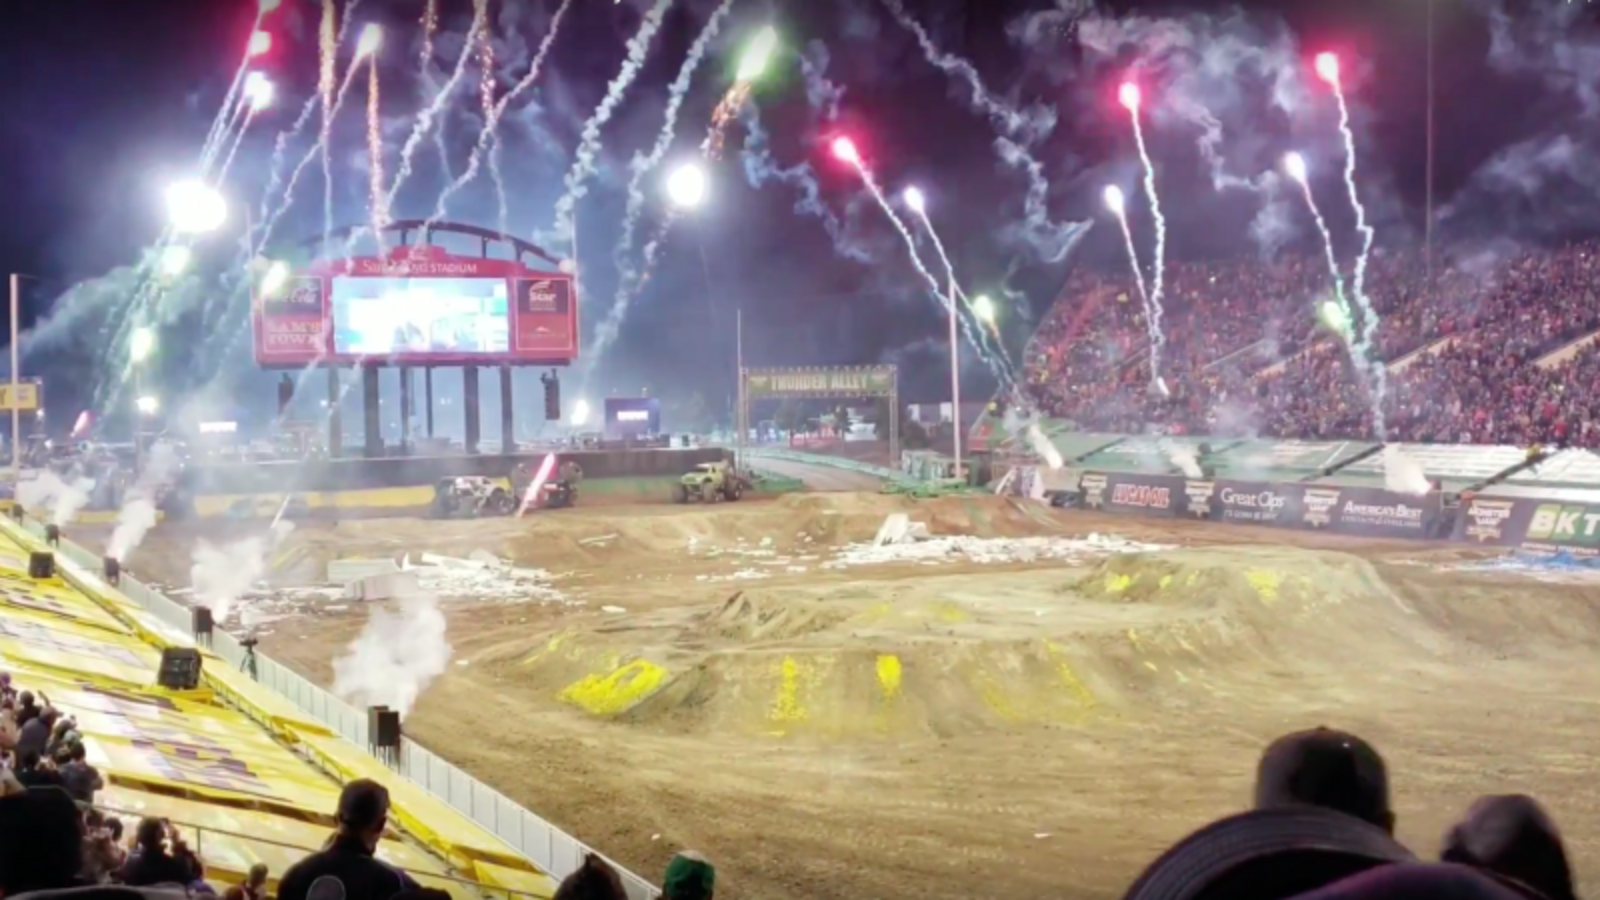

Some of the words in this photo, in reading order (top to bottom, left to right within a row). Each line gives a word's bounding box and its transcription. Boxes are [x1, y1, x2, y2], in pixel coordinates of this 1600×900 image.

[430, 264, 478, 273] STADIUM
[770, 375, 827, 391] THUNDER
[831, 373, 868, 390] ALLEY
[1112, 483, 1149, 507] LUCAS
[1220, 487, 1257, 507] Great
[1258, 490, 1285, 512] Clips
[1528, 508, 1600, 536] BKT
